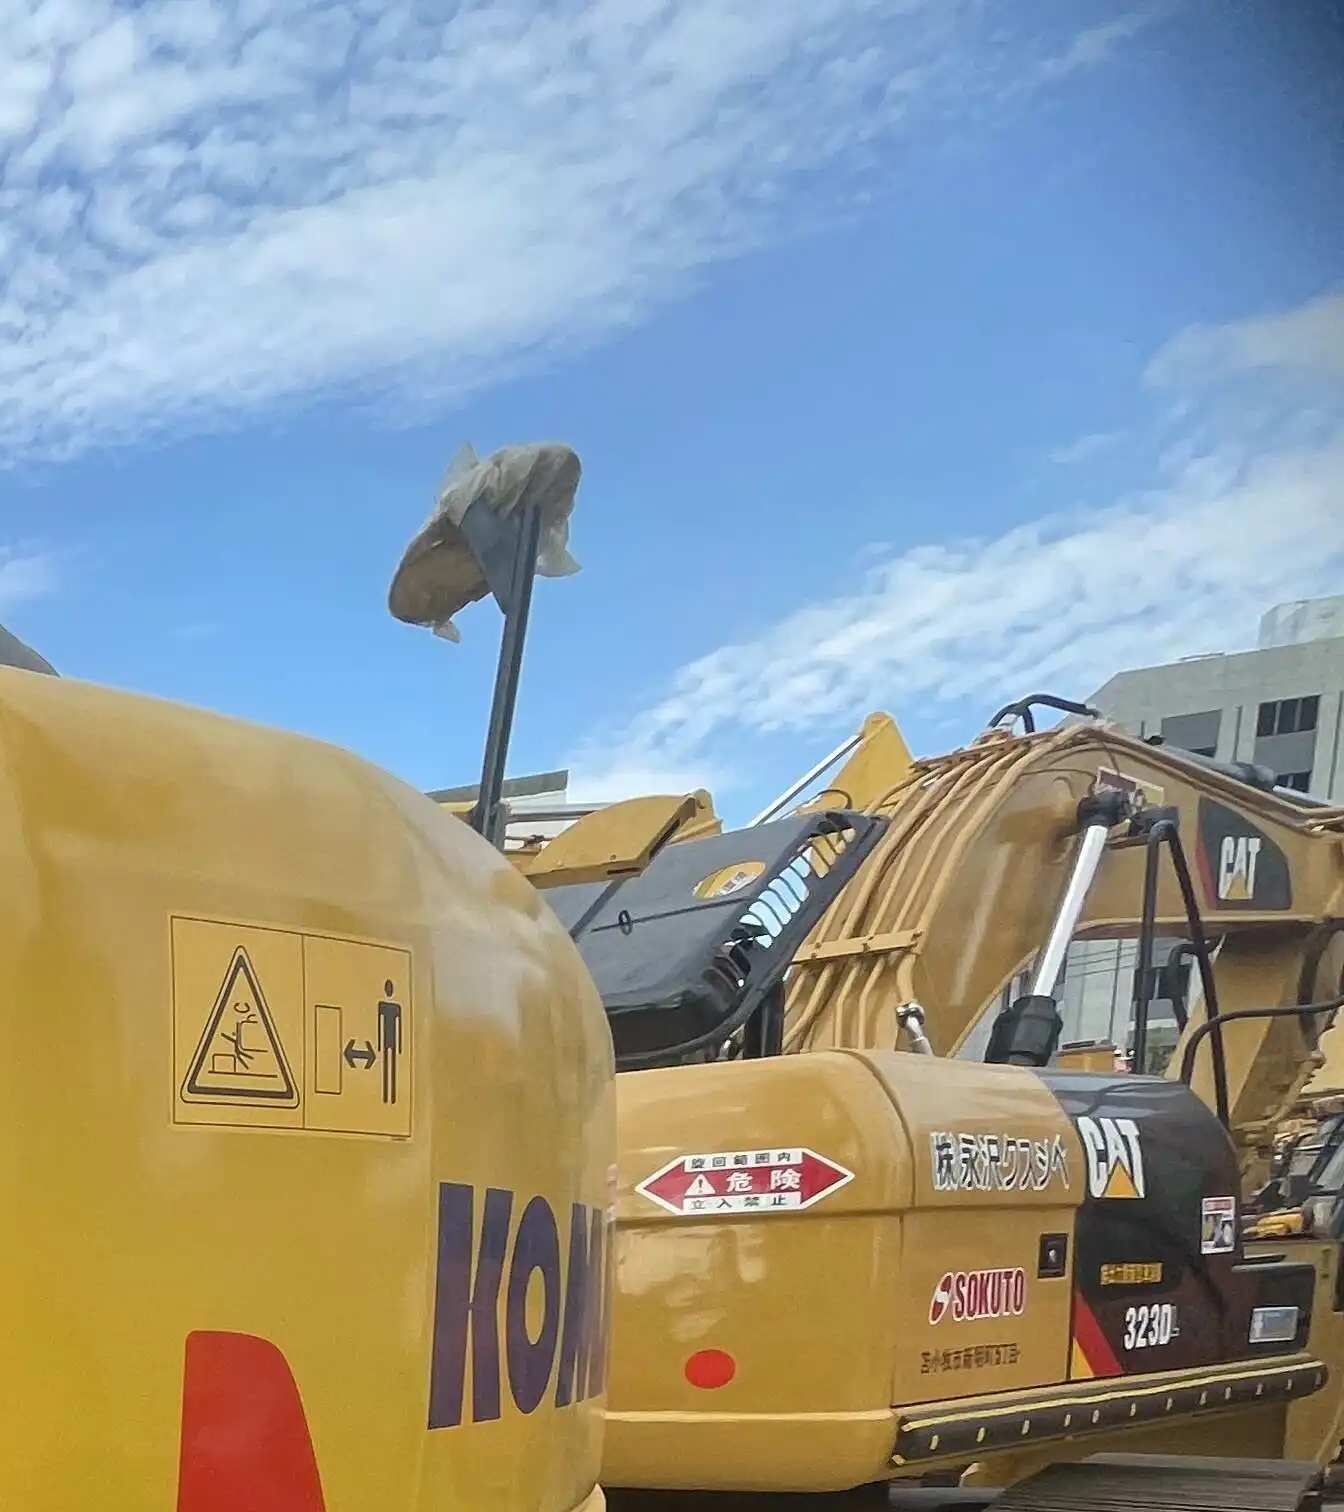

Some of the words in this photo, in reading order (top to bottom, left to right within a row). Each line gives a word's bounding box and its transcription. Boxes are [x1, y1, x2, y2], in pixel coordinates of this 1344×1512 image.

[1218, 836, 1261, 900] CAT
[726, 1168, 802, 1193] 危険
[1076, 1116, 1145, 1198] CAT
[691, 1194, 789, 1210] 立入禁止
[953, 1268, 1025, 1320] SOKUTO
